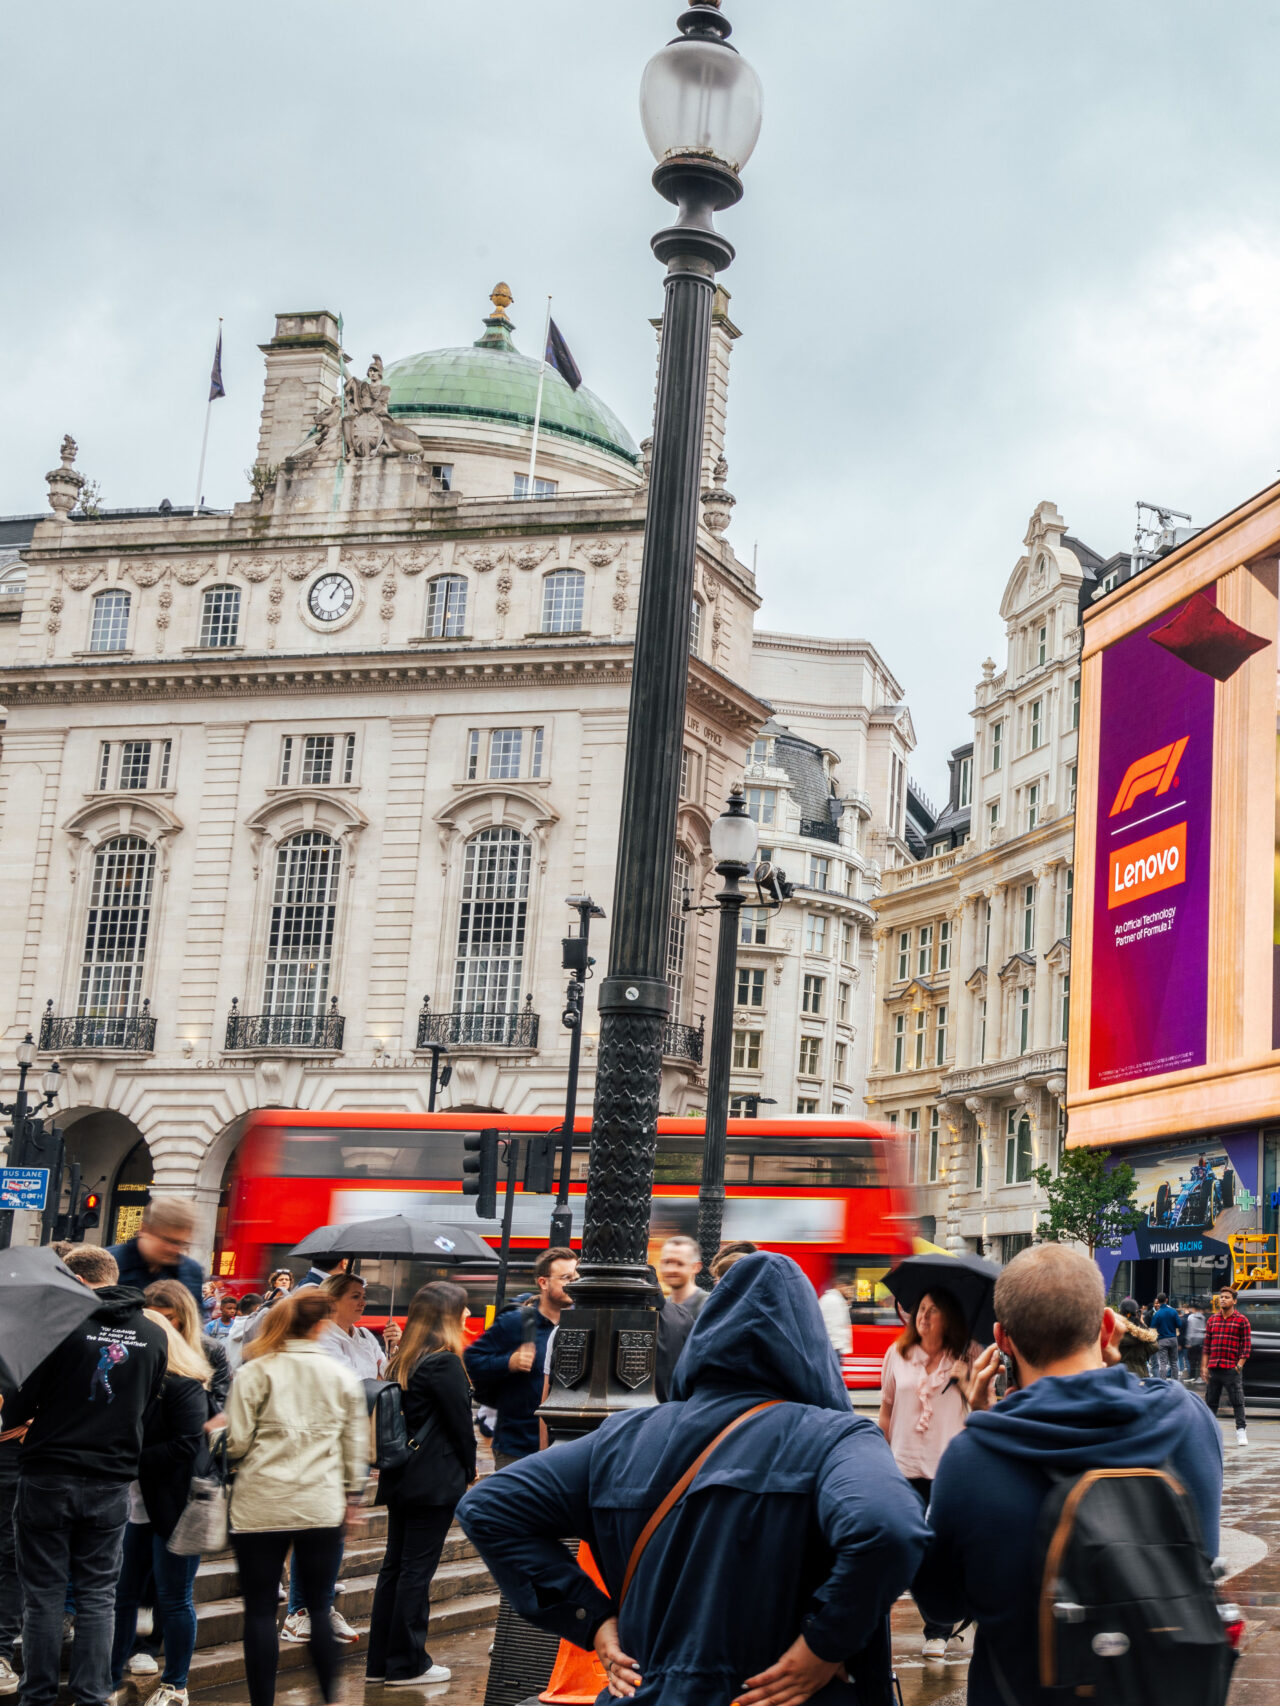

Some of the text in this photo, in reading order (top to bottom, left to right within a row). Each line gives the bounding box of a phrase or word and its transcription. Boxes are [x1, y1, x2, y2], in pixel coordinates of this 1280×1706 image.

[1114, 846, 1180, 893] Lenovo
[1114, 906, 1176, 935] An Official Technology
[1115, 933, 1137, 947] Partner
[1136, 928, 1144, 940] of
[1143, 921, 1168, 938] Formula
[196, 1059, 259, 1069] COUNTY
[300, 1059, 335, 1068] FIRE
[495, 1058, 533, 1067] LIFE
[1150, 1241, 1203, 1253] WILLIAMS RACING
